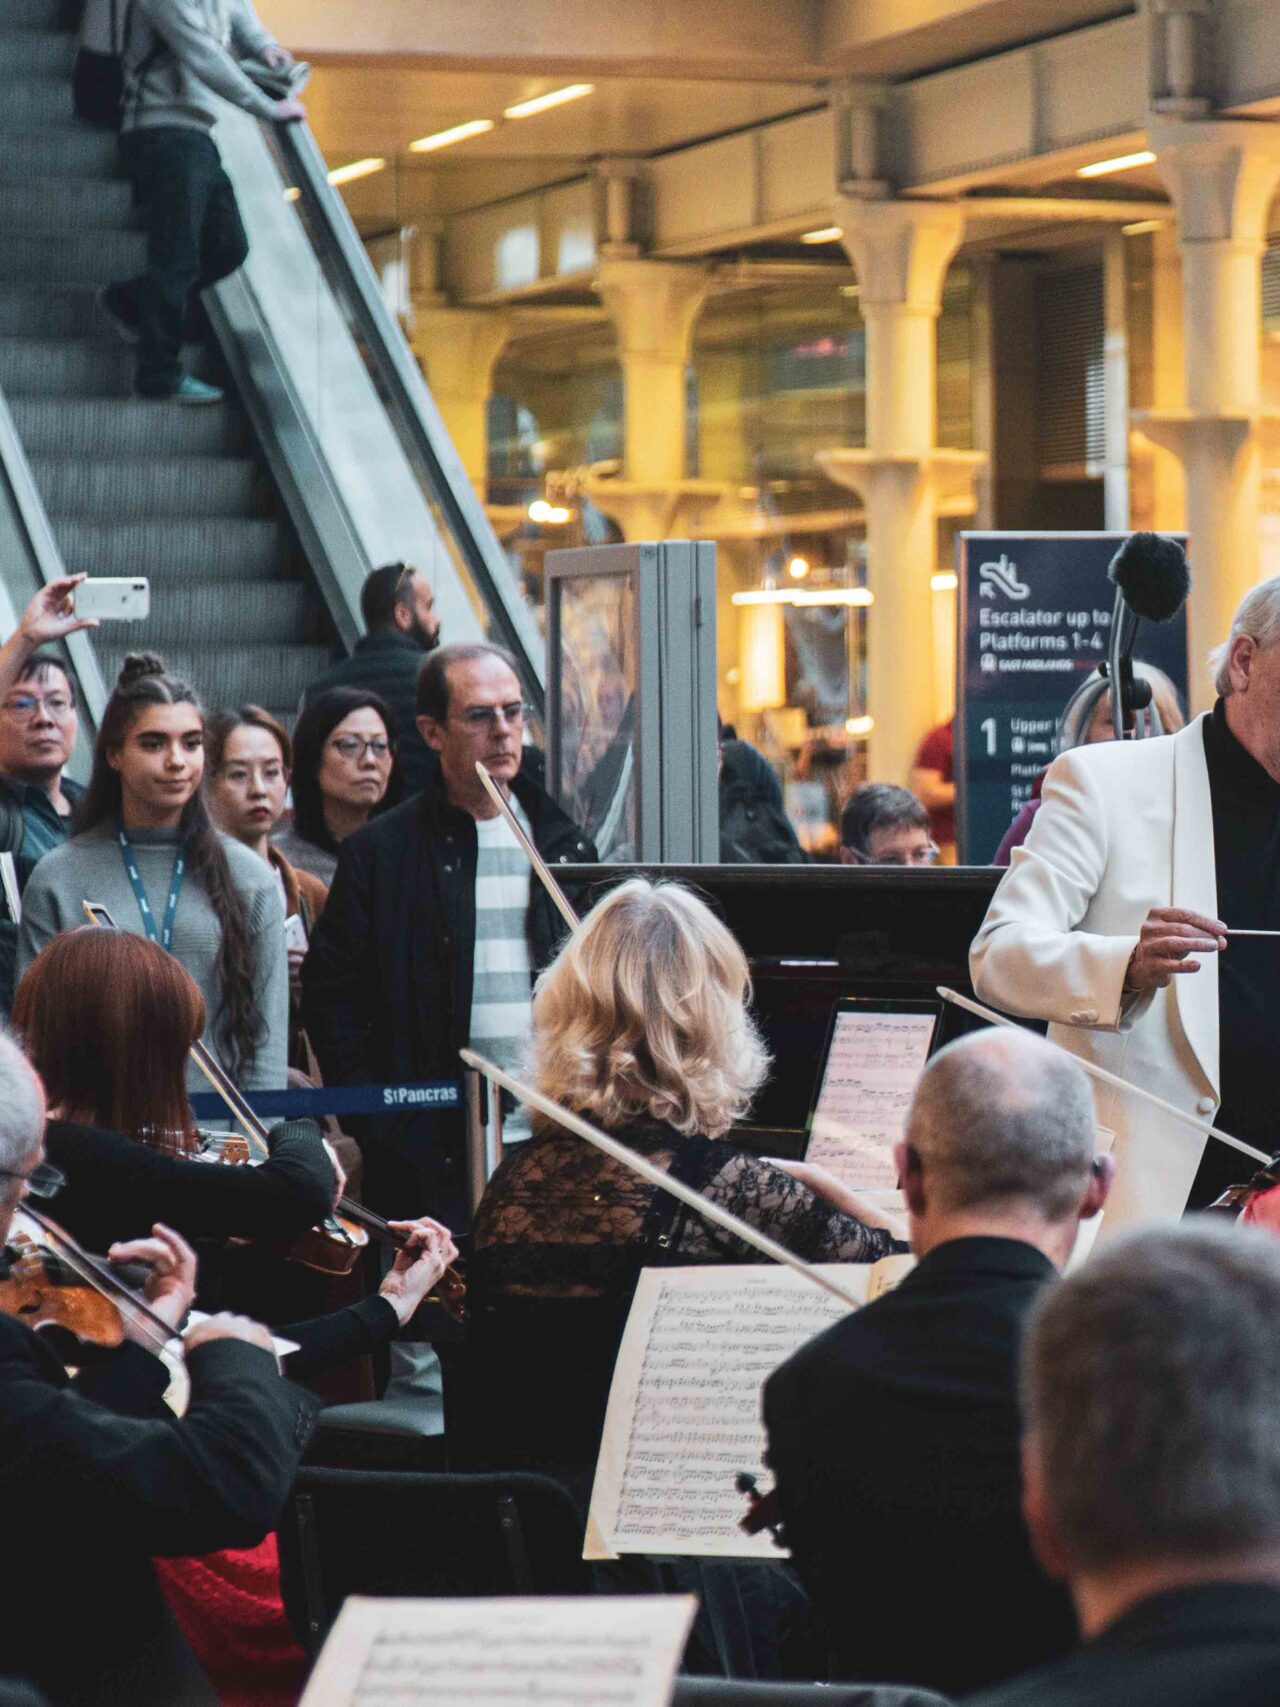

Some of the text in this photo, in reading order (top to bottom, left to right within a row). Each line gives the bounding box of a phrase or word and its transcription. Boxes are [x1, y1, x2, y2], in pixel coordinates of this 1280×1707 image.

[980, 608, 1111, 630] Escalator up to
[980, 632, 1103, 649] Platforms 1-4
[981, 718, 997, 755] 1
[1011, 718, 1051, 734] Upper
